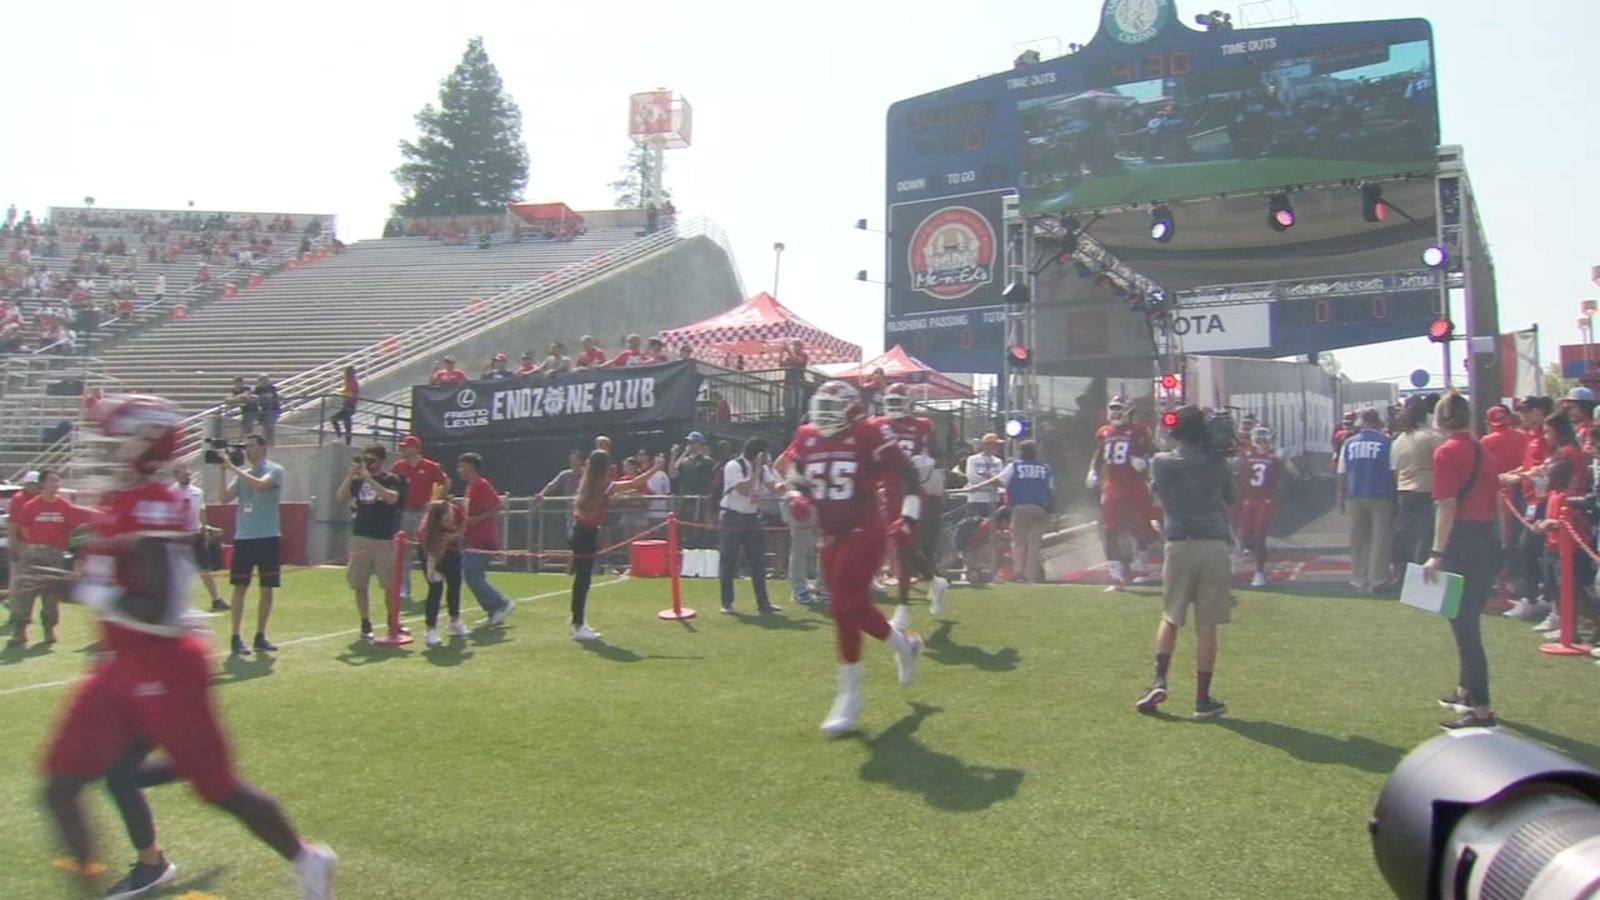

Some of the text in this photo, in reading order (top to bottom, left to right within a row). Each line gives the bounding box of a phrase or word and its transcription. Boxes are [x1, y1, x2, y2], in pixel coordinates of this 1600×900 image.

[1220, 37, 1277, 56] TIME OUTS
[1006, 72, 1056, 90] TIME OUTS
[896, 178, 925, 192] DOWN
[946, 171, 975, 184] TO GO
[929, 314, 969, 329] PASSING
[600, 377, 656, 411] CLUB
[444, 408, 489, 419] FRESNO
[444, 417, 489, 428] LEXUS
[1104, 441, 1129, 465] 18
[1348, 441, 1384, 461] STAFF
[1016, 464, 1047, 480] STAFF
[1250, 463, 1267, 487] 3
